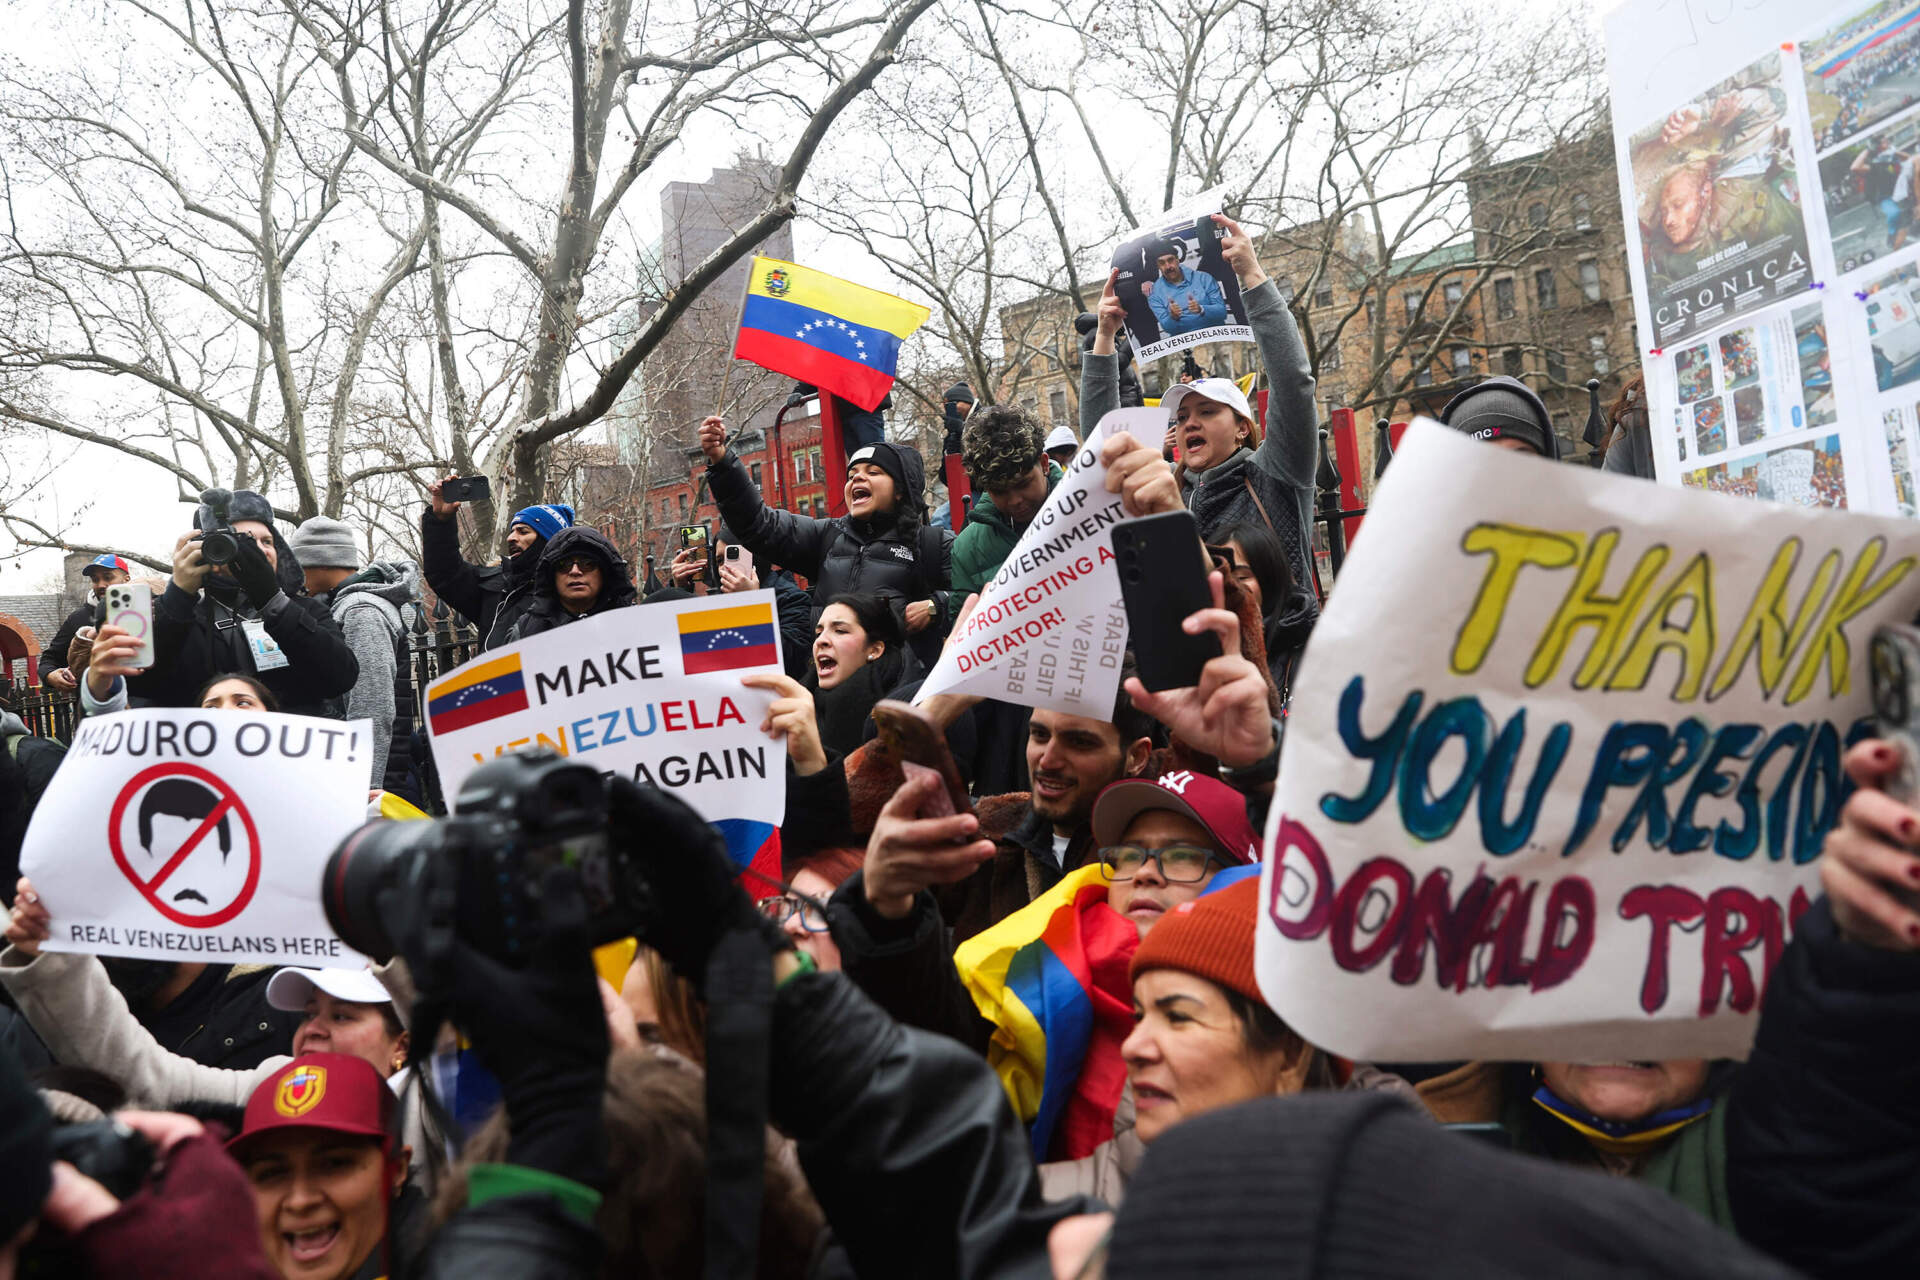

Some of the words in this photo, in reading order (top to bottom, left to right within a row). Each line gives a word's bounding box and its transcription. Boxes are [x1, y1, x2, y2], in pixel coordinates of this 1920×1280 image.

[1140, 344, 1166, 358] REAL
[1165, 328, 1230, 349] VENEZUELANS
[1230, 327, 1250, 337] HERE
[1057, 488, 1088, 516] UP
[967, 556, 1094, 637] PROTECTING
[1098, 546, 1116, 565] A
[1448, 522, 1918, 705] THANK
[957, 607, 1066, 673] DICTATOR!
[535, 644, 664, 705] MAKE
[72, 719, 218, 758] MADURO
[235, 722, 358, 763] OUT!
[473, 696, 746, 765] NEZUELA
[633, 746, 766, 790] AGAIN
[1319, 675, 1572, 857] YOU
[1561, 715, 1878, 863] PRESID
[1268, 813, 1597, 993] DONALD
[71, 925, 121, 945] REAL
[125, 929, 277, 953] VENEZUELANS
[283, 937, 341, 957] HERE
